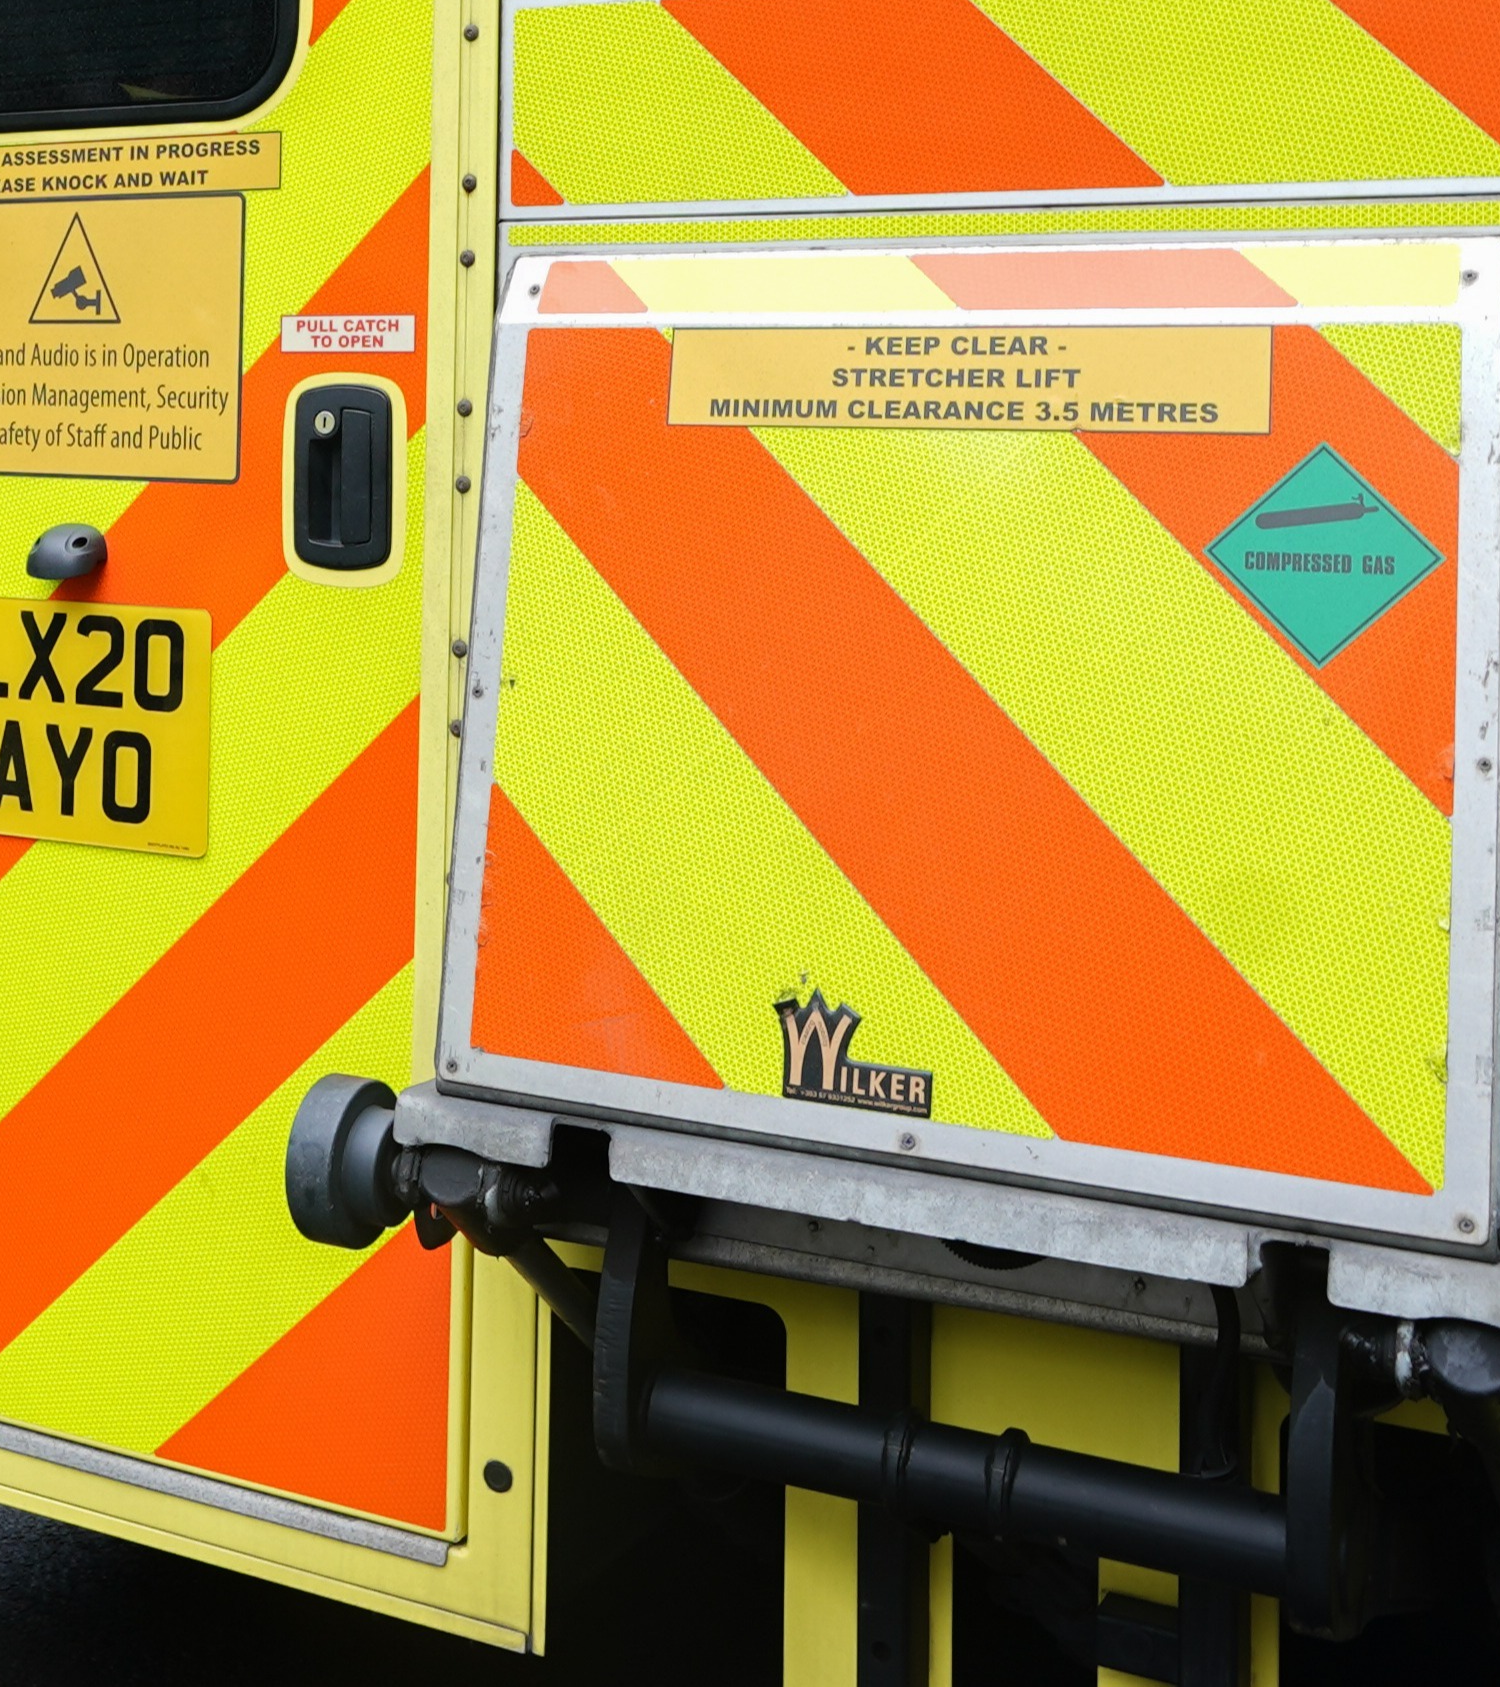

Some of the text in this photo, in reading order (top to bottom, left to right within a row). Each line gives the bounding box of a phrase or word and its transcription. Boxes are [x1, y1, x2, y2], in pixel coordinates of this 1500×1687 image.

[1, 147, 123, 167] ASSESSMENT
[130, 145, 148, 160] IN
[156, 140, 260, 159] PROGRESS
[42, 174, 107, 191] KNOCK
[114, 173, 152, 188] AND
[160, 170, 208, 186] WAIT
[297, 319, 399, 332] PULL CATCH
[311, 335, 383, 348] TO OPEN
[866, 337, 940, 355] KEEP
[951, 336, 1048, 355] CLEAR
[31, 343, 79, 366] Audio
[85, 344, 96, 367] is
[103, 344, 117, 367] in
[123, 343, 209, 373] Operation
[832, 368, 1081, 388] STRETCHER LIFT
[32, 383, 150, 413] Management,
[157, 384, 228, 416] Security
[710, 399, 1218, 423] MINIMUM CLEARANCE 3.5 METRES
[46, 423, 63, 446] of
[67, 423, 107, 447] Staff
[111, 425, 142, 449] and
[149, 425, 202, 450] Public
[1245, 551, 1395, 575] COMPRESSED GAS
[784, 1009, 926, 1104] WILKER
